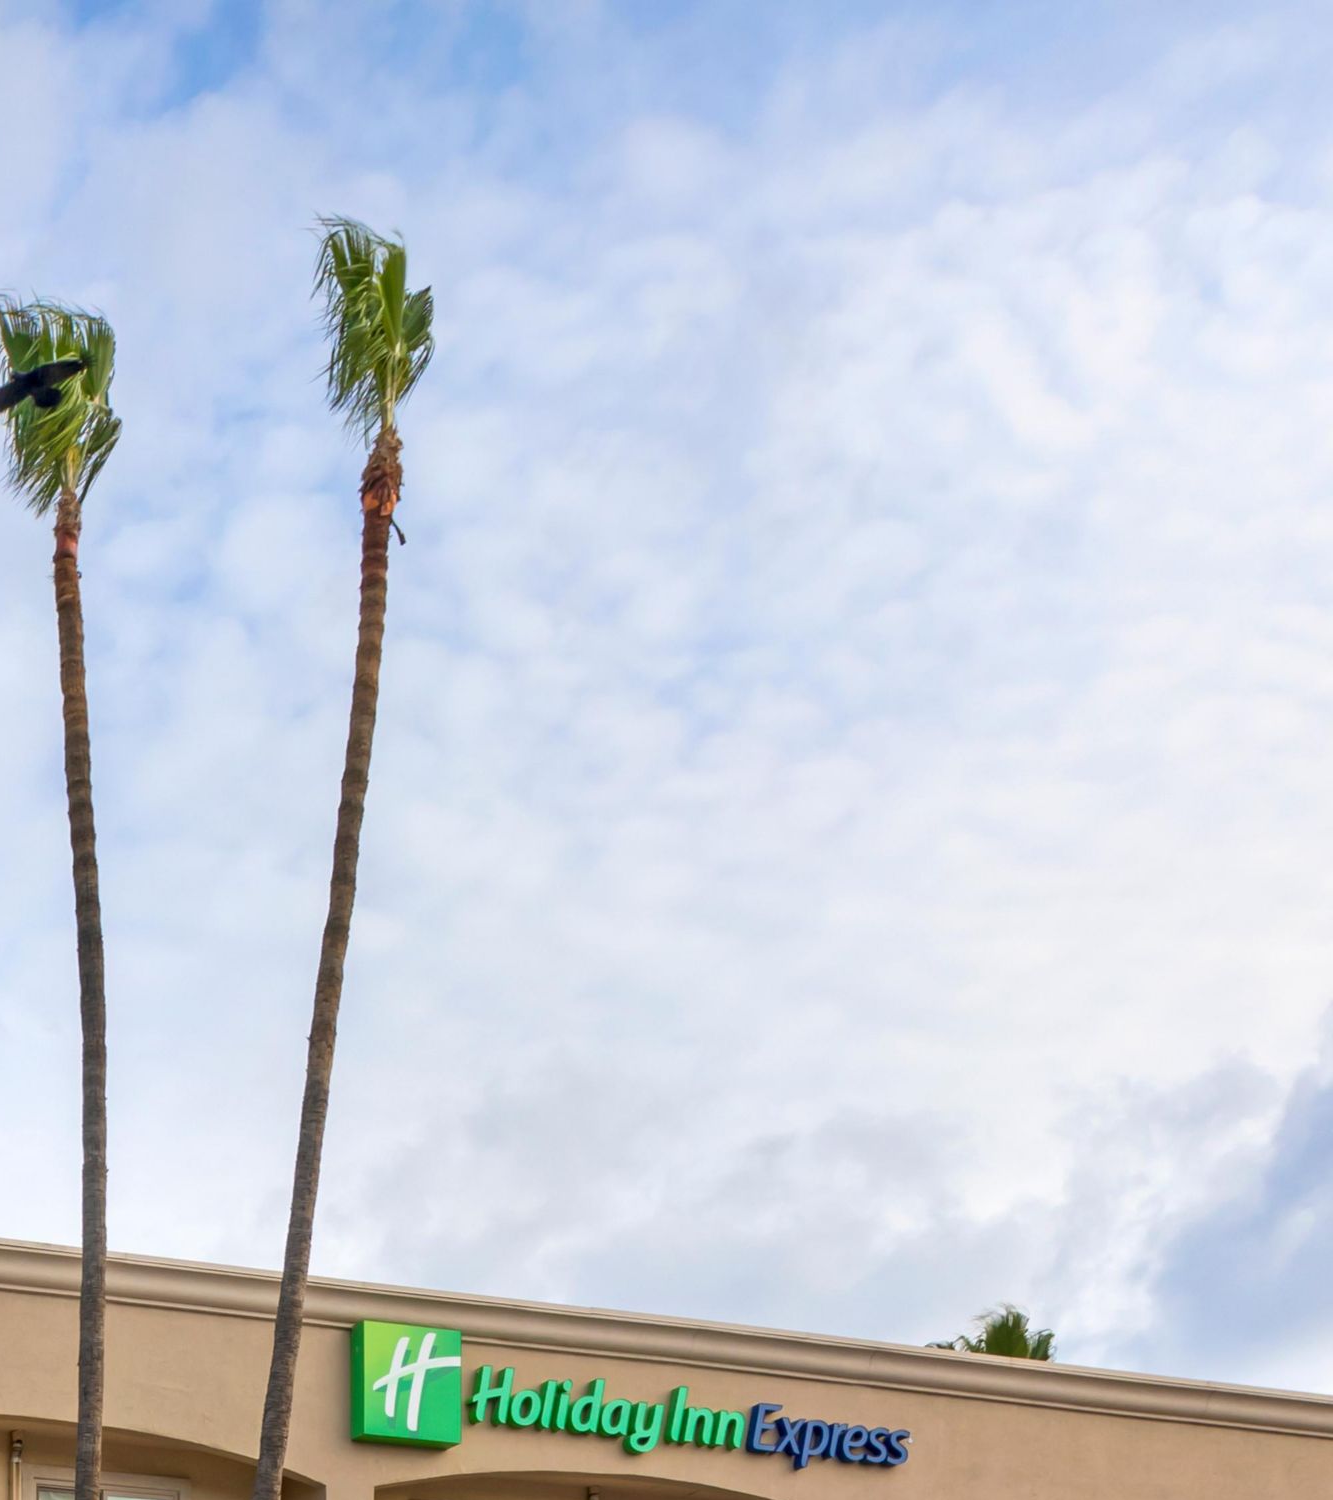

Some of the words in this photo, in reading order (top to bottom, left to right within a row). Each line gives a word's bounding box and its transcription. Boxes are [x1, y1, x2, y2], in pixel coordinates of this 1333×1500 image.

[468, 1364, 665, 1454] Holiday
[665, 1385, 746, 1450] Inn
[746, 1402, 911, 1470] Express
